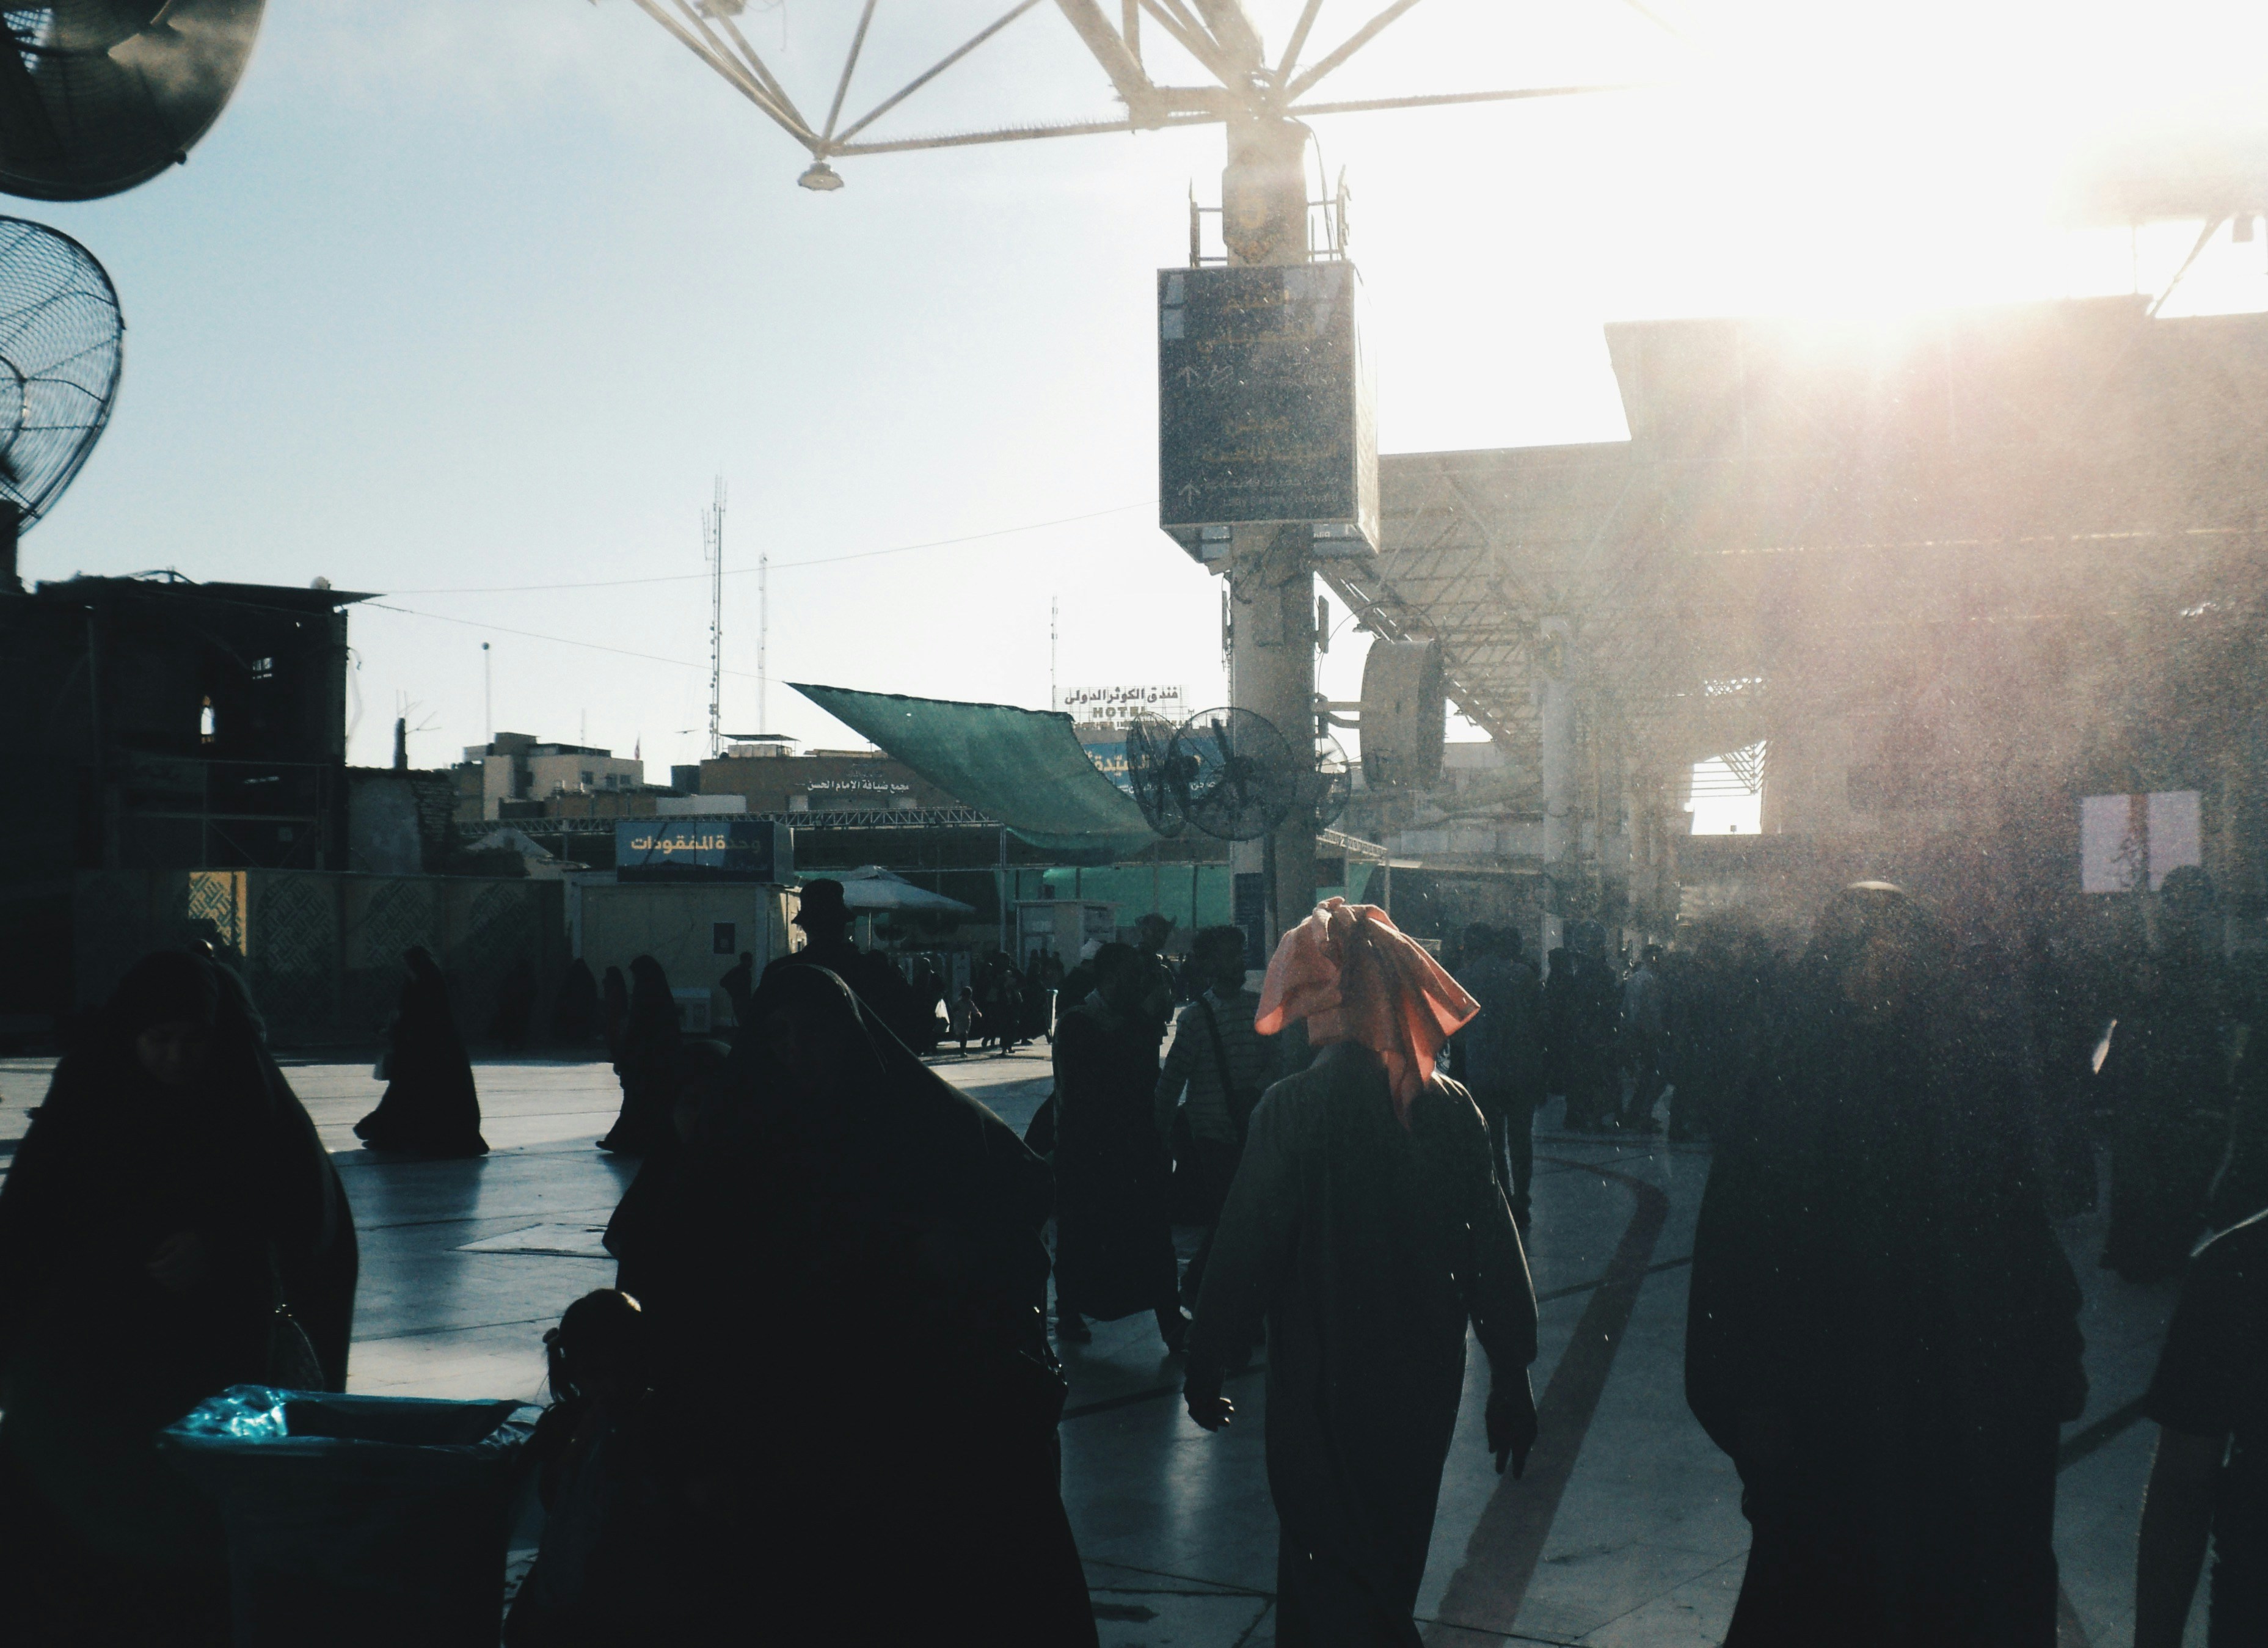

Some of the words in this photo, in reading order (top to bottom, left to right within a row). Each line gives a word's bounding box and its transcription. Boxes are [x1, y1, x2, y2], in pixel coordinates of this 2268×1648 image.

[1107, 687, 1145, 704] الكوثر
[1147, 687, 1178, 702] فندق
[1093, 707, 1145, 718] HOTEL
[808, 780, 834, 790] الحسن
[863, 779, 888, 792] ضيافة
[891, 785, 910, 793] مجمع
[631, 835, 713, 854] المفقودات
